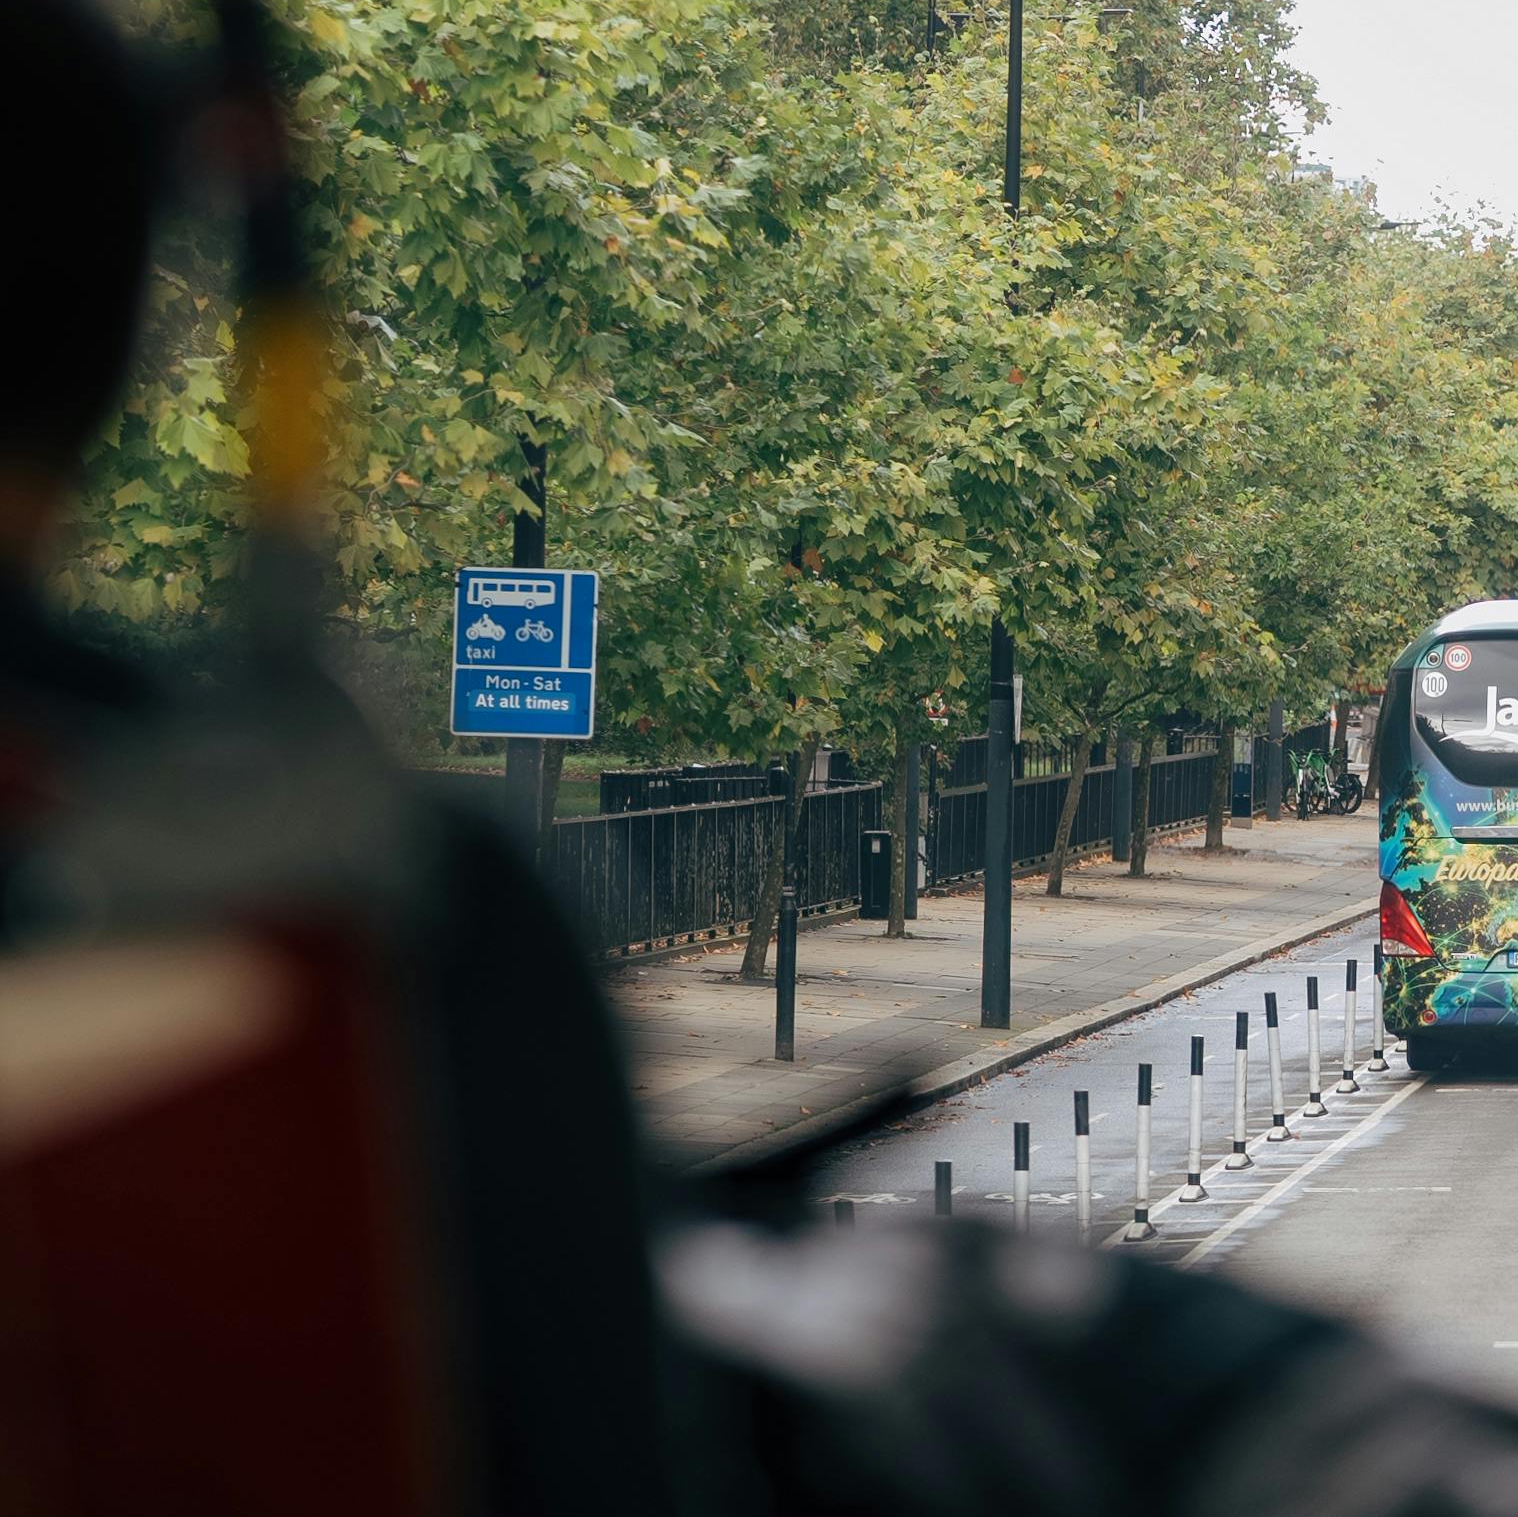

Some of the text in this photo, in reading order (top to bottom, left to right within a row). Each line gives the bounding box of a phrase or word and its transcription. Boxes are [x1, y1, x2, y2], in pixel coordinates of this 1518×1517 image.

[466, 645, 496, 659] taxi
[1451, 653, 1466, 663] 100
[486, 675, 520, 690] Mon
[533, 676, 562, 691] Sat
[1426, 677, 1445, 693] 100
[475, 694, 569, 711] At all times
